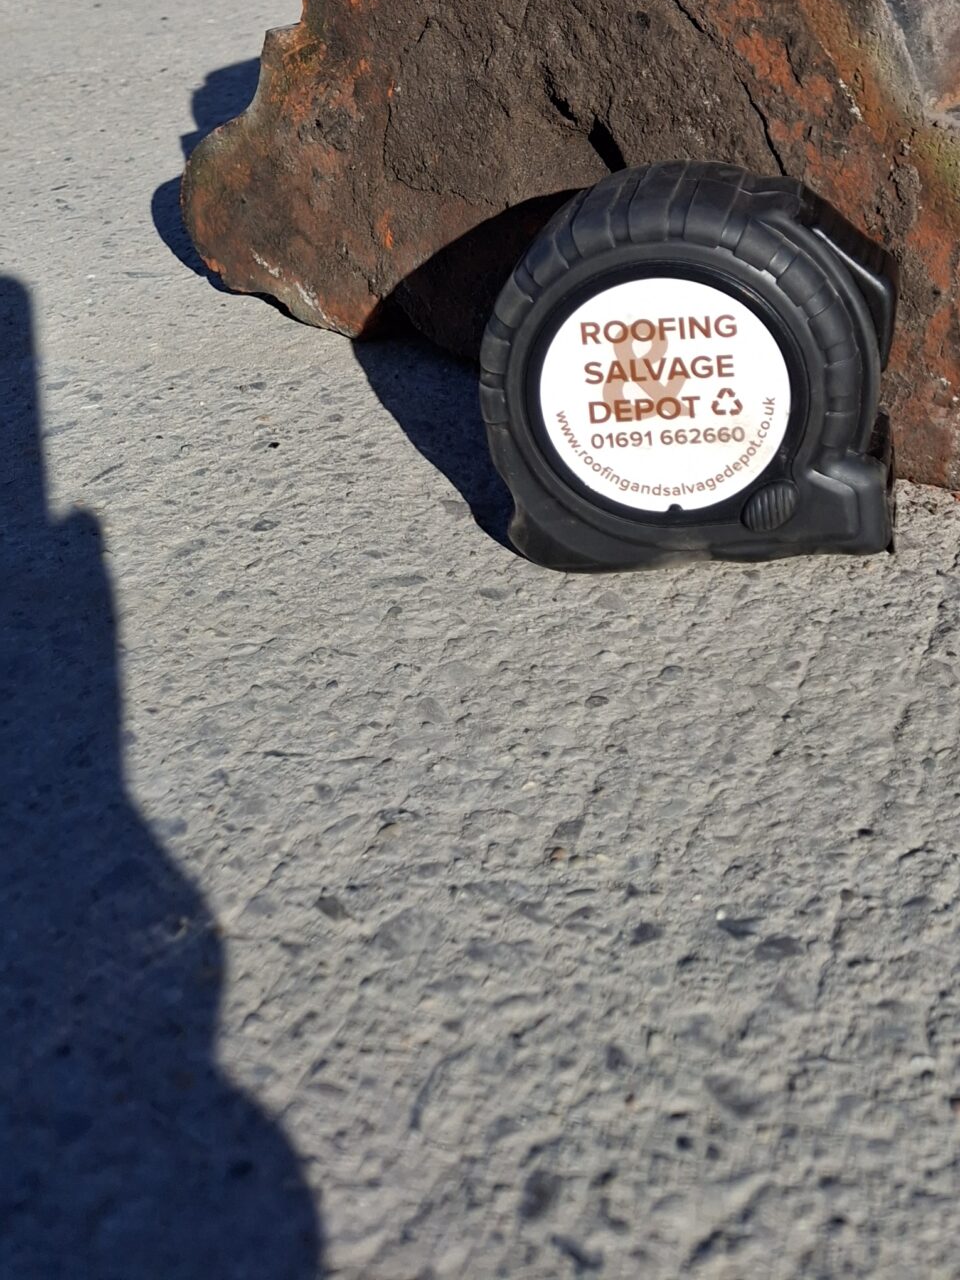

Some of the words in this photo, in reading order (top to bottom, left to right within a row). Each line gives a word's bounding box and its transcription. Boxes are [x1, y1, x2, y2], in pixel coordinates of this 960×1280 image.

[580, 314, 737, 345] ROOFING
[584, 354, 735, 384] SALVAGE
[588, 395, 700, 424] DEPOT
[555, 396, 776, 497] www.roofingandsalvagedepot.co.uk
[590, 430, 652, 449] 01691
[660, 426, 745, 445] 662660
